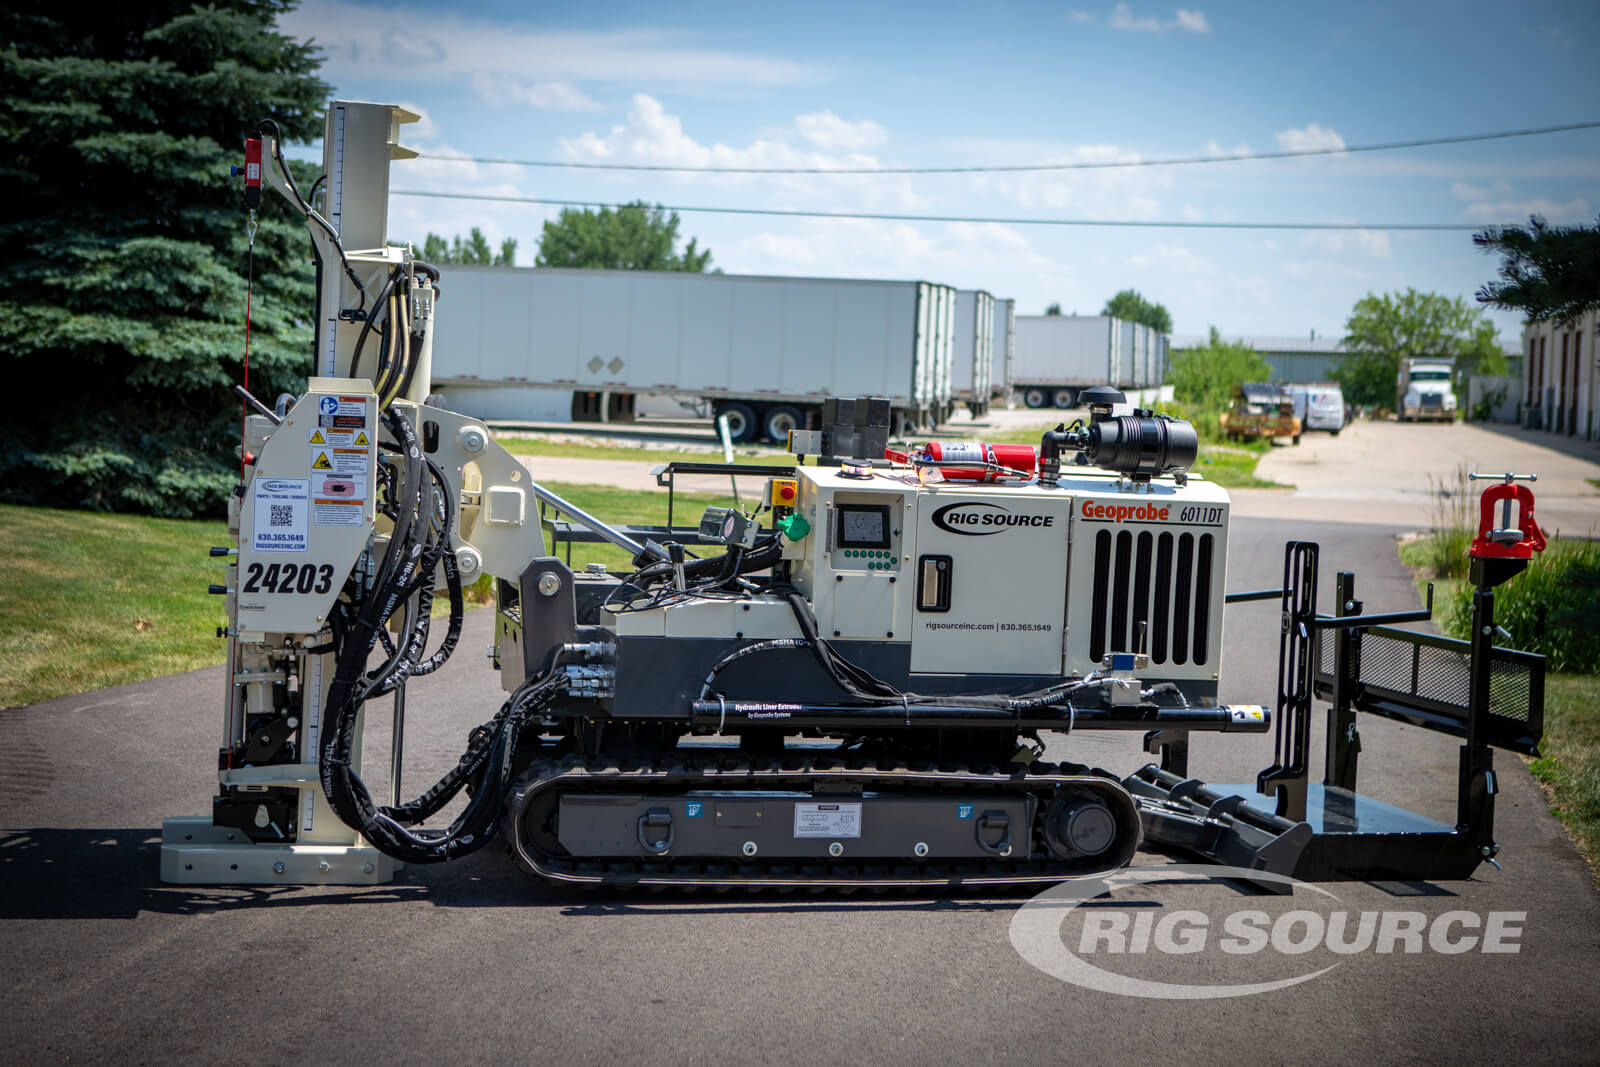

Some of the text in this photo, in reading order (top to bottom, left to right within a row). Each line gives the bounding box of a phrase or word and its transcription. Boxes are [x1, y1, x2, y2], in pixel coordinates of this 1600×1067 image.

[1082, 500, 1224, 523] Geoprobe 6011DT
[948, 512, 1054, 528] RIG SOURCE
[258, 533, 304, 542] 630.365.1649
[243, 562, 334, 595] 24203
[925, 622, 995, 633] rigsourceinc.com
[1000, 623, 1052, 632] 630.365.1649
[771, 639, 795, 647] MSHA
[735, 703, 762, 712] Hydraulic
[762, 703, 777, 711] Liner
